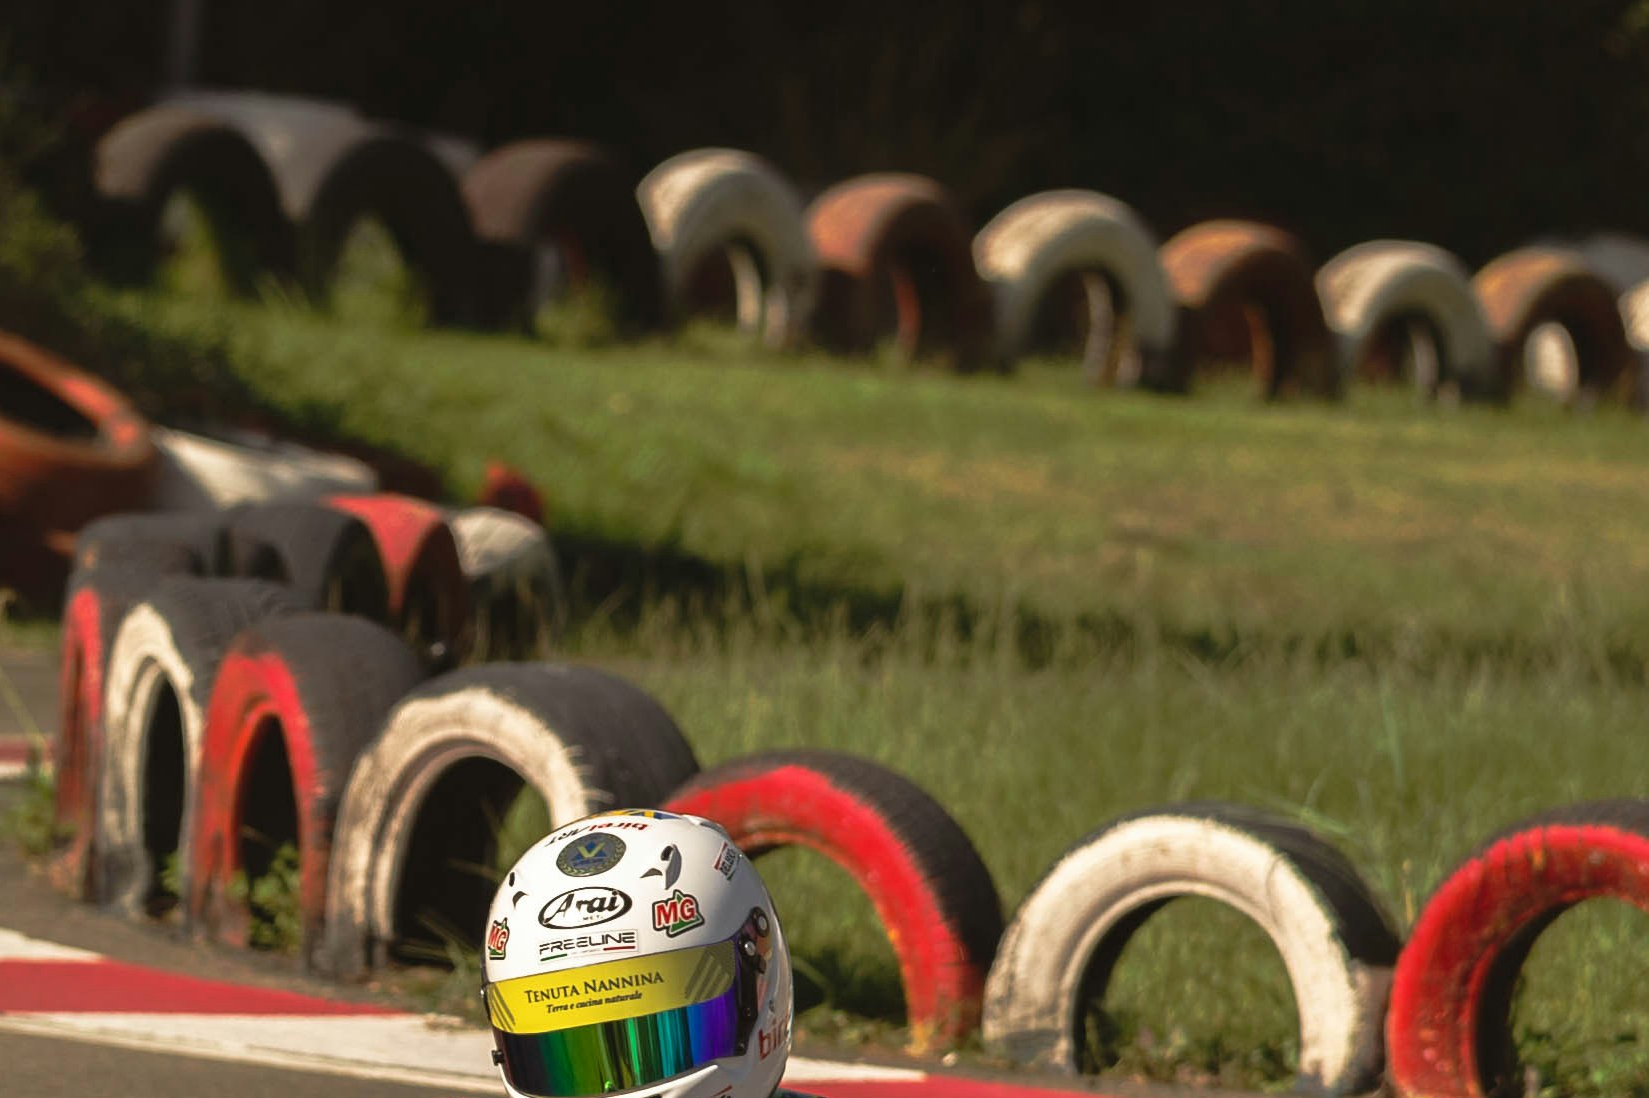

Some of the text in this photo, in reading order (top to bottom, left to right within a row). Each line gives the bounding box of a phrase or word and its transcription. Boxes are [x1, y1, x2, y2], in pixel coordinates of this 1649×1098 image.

[543, 889, 620, 924] Arai
[655, 898, 696, 927] MG
[488, 925, 507, 953] MG
[538, 931, 636, 956] FREELINE
[524, 971, 665, 1004] TENUTA NANNINA
